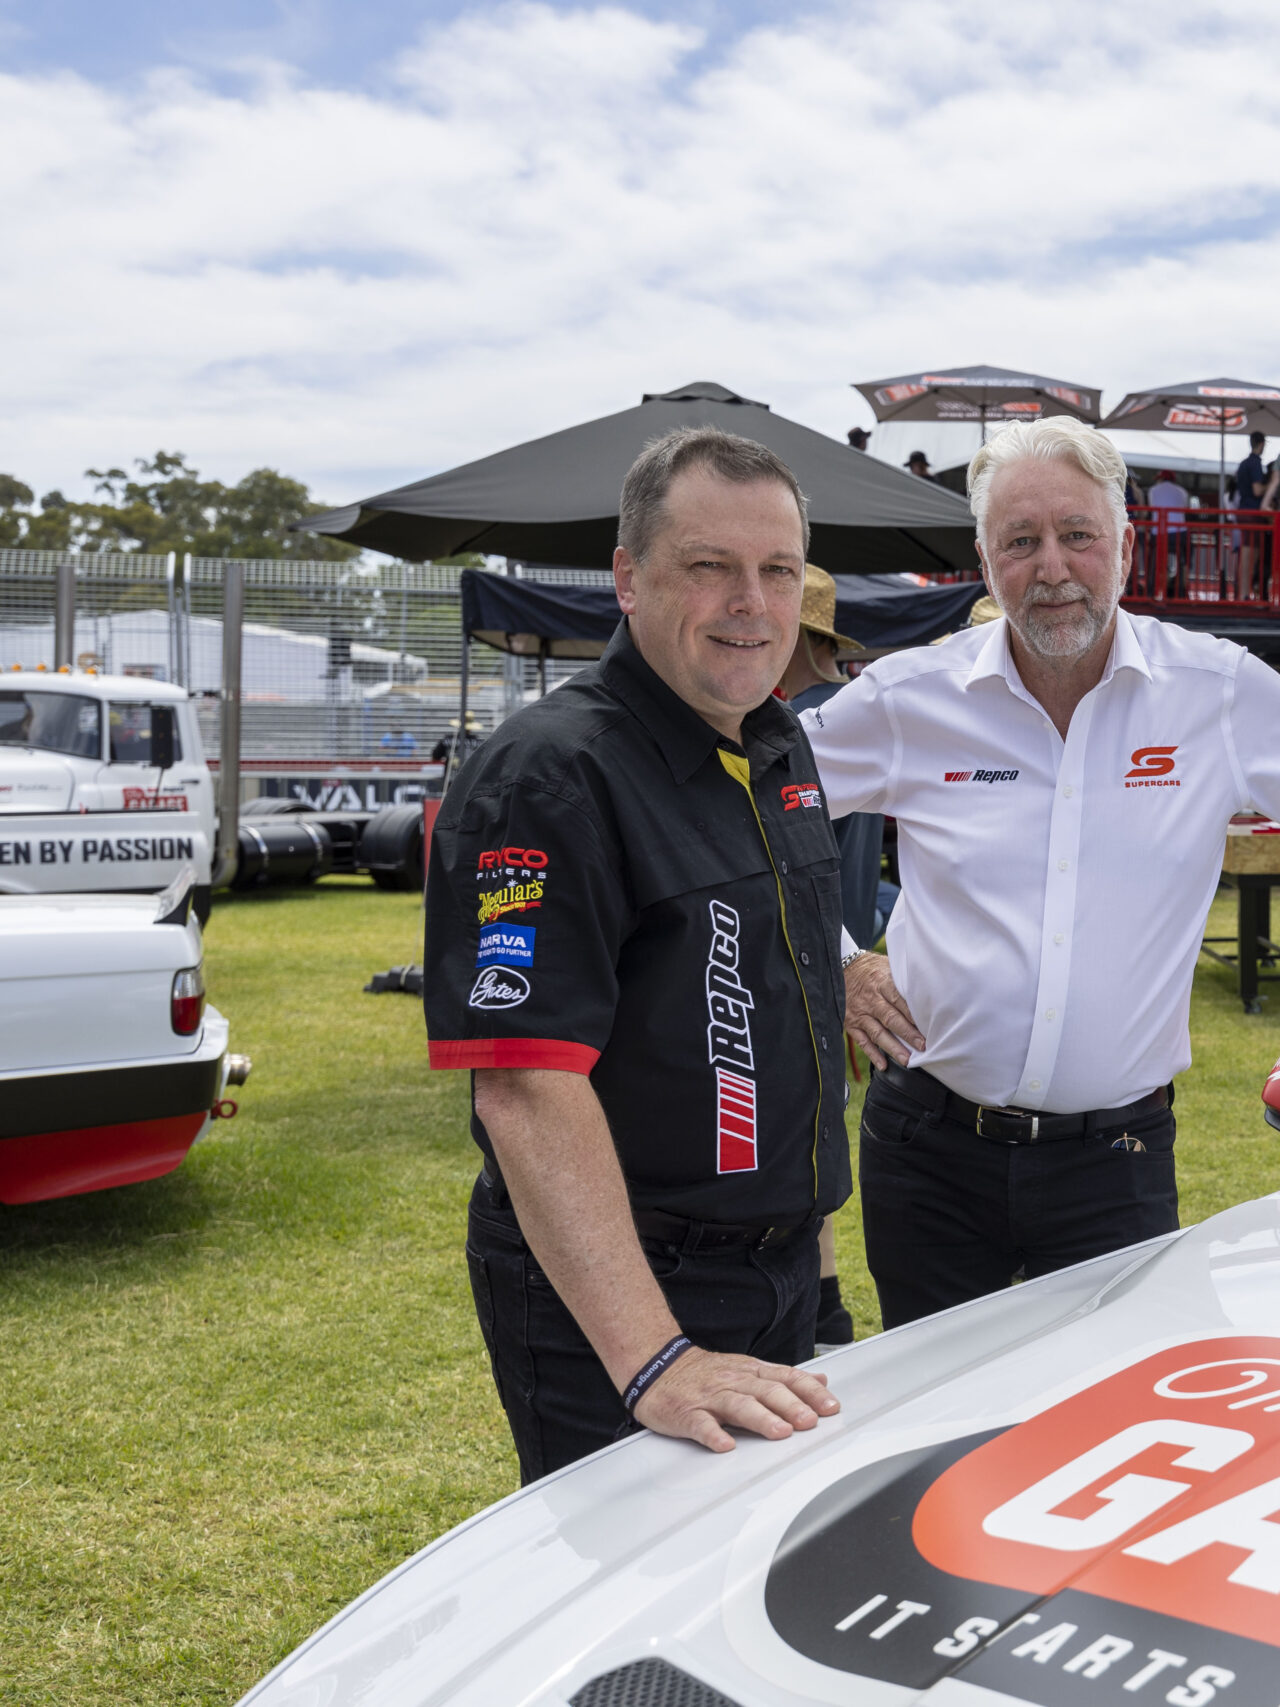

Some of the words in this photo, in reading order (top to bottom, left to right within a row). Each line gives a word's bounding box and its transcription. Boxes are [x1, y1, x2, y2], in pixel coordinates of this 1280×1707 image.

[972, 769, 1020, 784] Repco
[1124, 780, 1181, 789] SUPERCARS
[40, 840, 74, 864] BY
[82, 838, 193, 863] PASSION
[478, 847, 549, 871] RYCO
[476, 867, 547, 881] FILTERS
[479, 934, 527, 949] NARVA
[506, 948, 532, 958] FURTHER
[706, 900, 755, 1070] Repco
[636, 1360, 665, 1387] Lounge
[834, 1593, 931, 1640] IT
[932, 1612, 1236, 1707] STARTS
